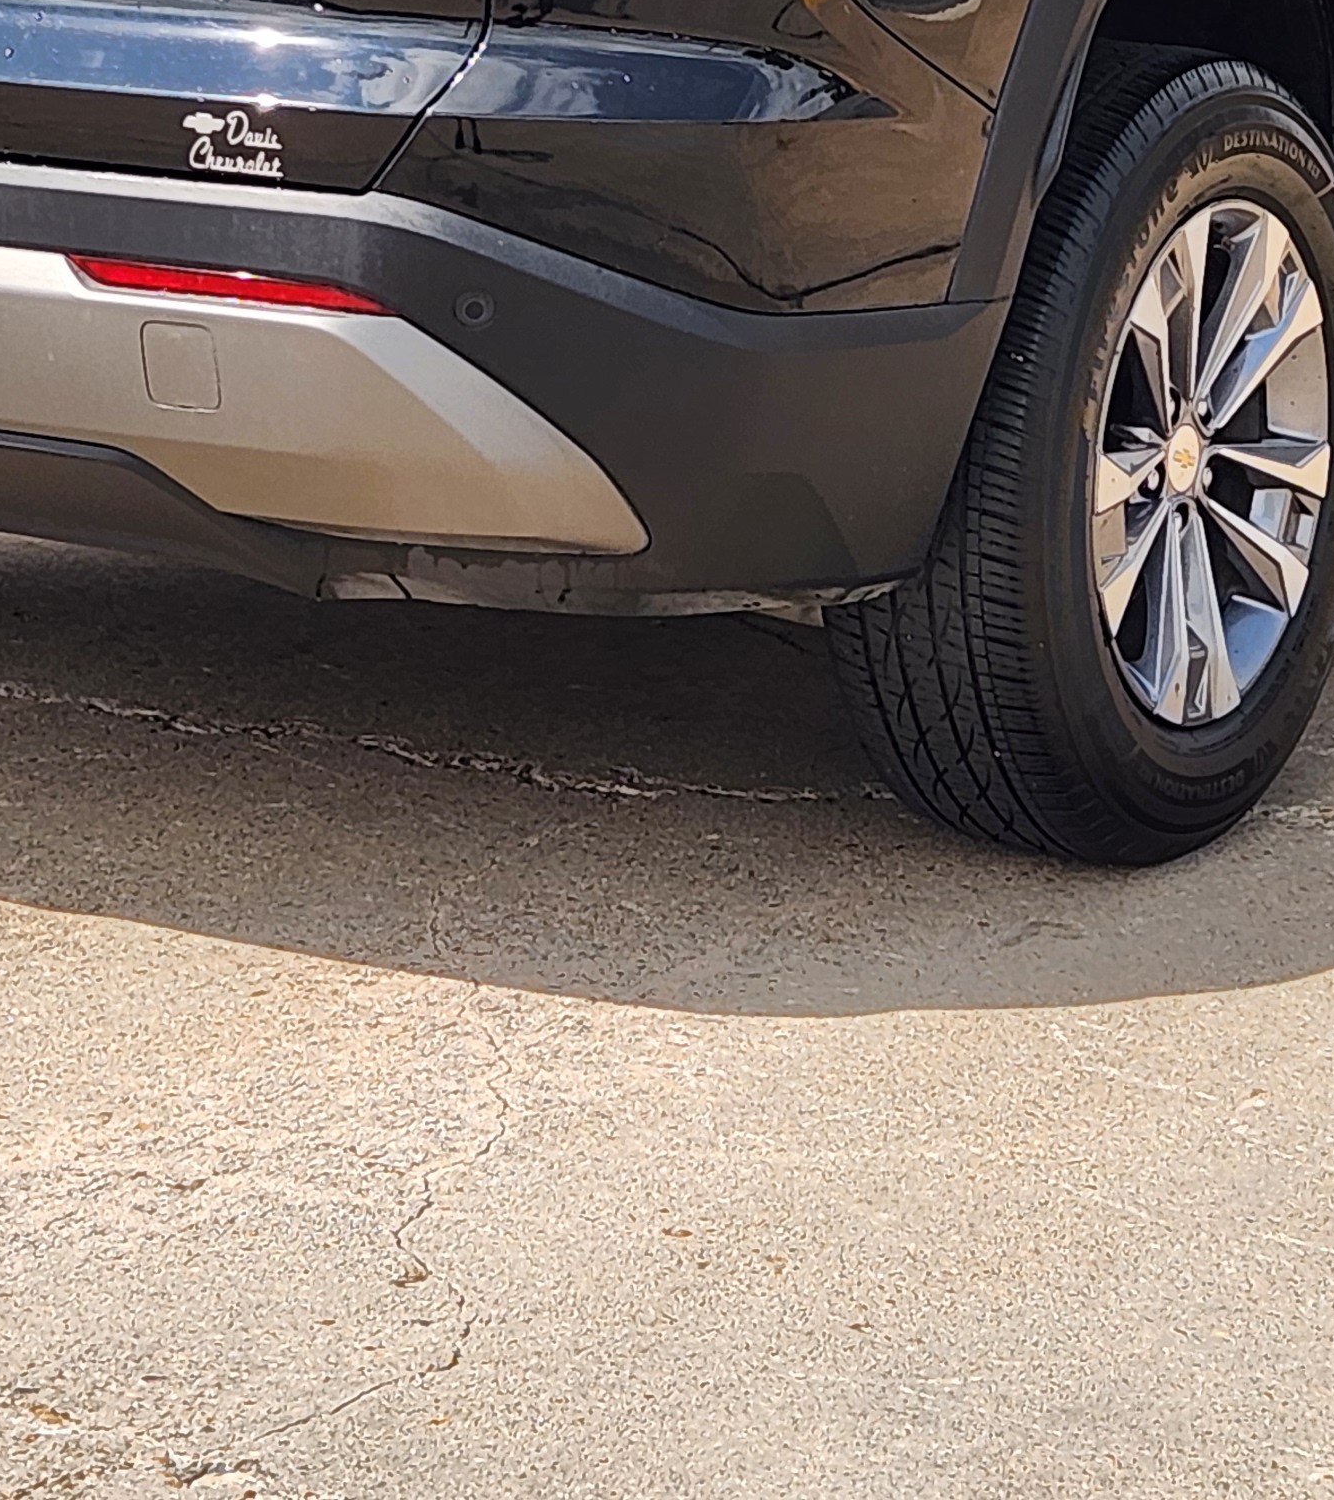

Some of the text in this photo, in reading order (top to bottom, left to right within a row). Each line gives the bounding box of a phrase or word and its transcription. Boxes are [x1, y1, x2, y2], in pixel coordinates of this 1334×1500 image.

[226, 110, 283, 150] Davis
[1223, 129, 1307, 168] DESTINATION
[189, 135, 284, 177] Chevrolet
